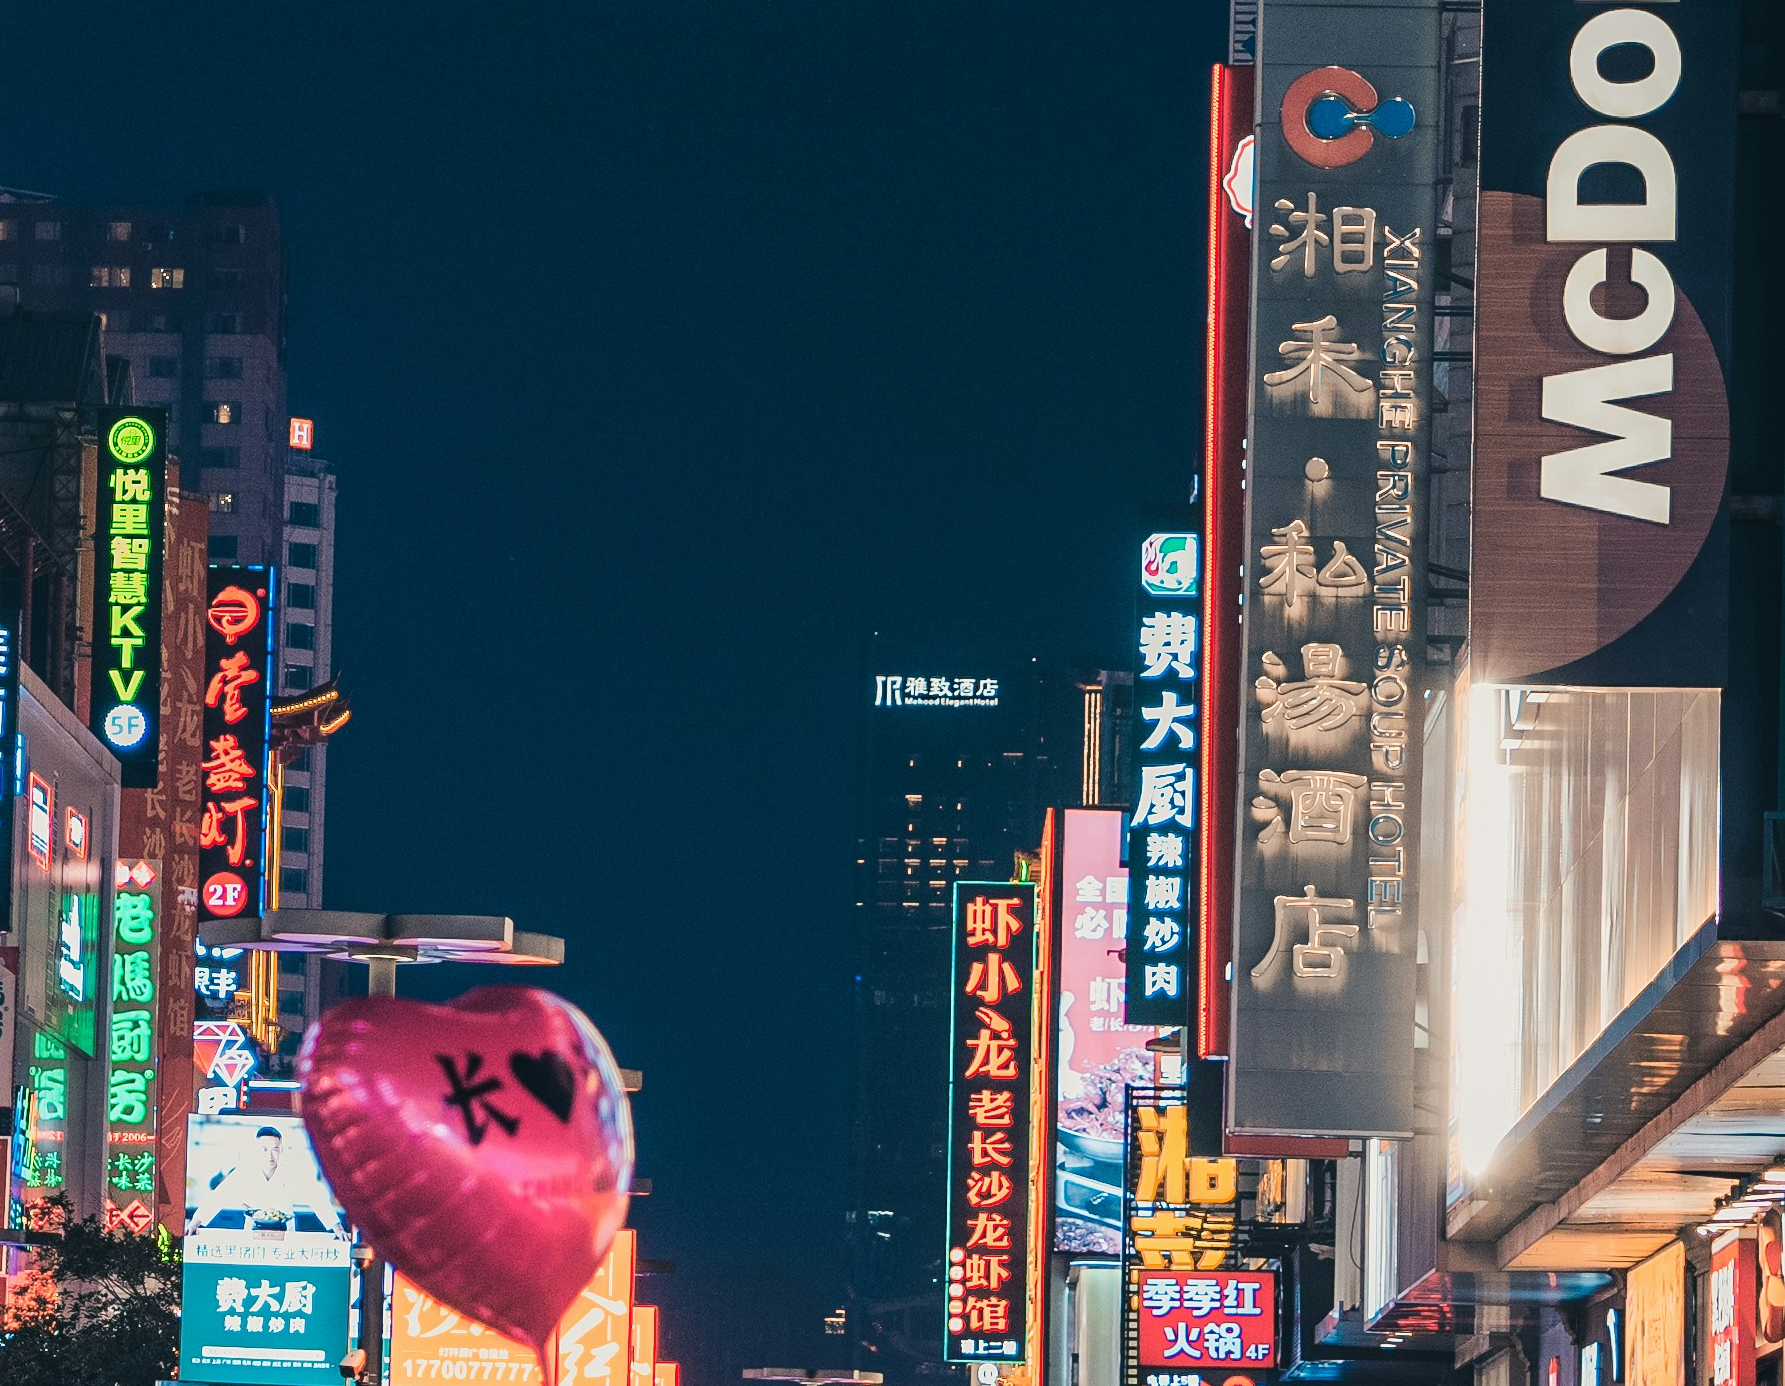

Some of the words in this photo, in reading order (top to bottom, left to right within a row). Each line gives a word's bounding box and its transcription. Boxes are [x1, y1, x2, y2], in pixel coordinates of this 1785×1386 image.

[1378, 226, 1422, 430] XIANGHE
[291, 422, 312, 446] H
[1374, 440, 1415, 637] PRIVATE
[108, 468, 152, 702] 悦里智慧KTV
[110, 716, 141, 735] 5F
[905, 676, 999, 697] 雅致酒店
[974, 697, 999, 706] Hotel
[1131, 612, 1196, 827] 费大厨
[1371, 643, 1411, 772] SOUP
[208, 881, 242, 907] 2F
[1367, 783, 1406, 929] HOTEL
[1142, 833, 1184, 997] 辣椒炒肉
[964, 896, 1023, 1080] 虾小龙
[963, 1091, 1015, 1333] 老长沙龙虾馆
[216, 1277, 317, 1314] 费大厨
[224, 1315, 306, 1334] 辣椒炒肉
[1142, 1277, 1263, 1317] 季季红
[1162, 1320, 1243, 1360] 火锅
[1245, 1342, 1271, 1361] 4F
